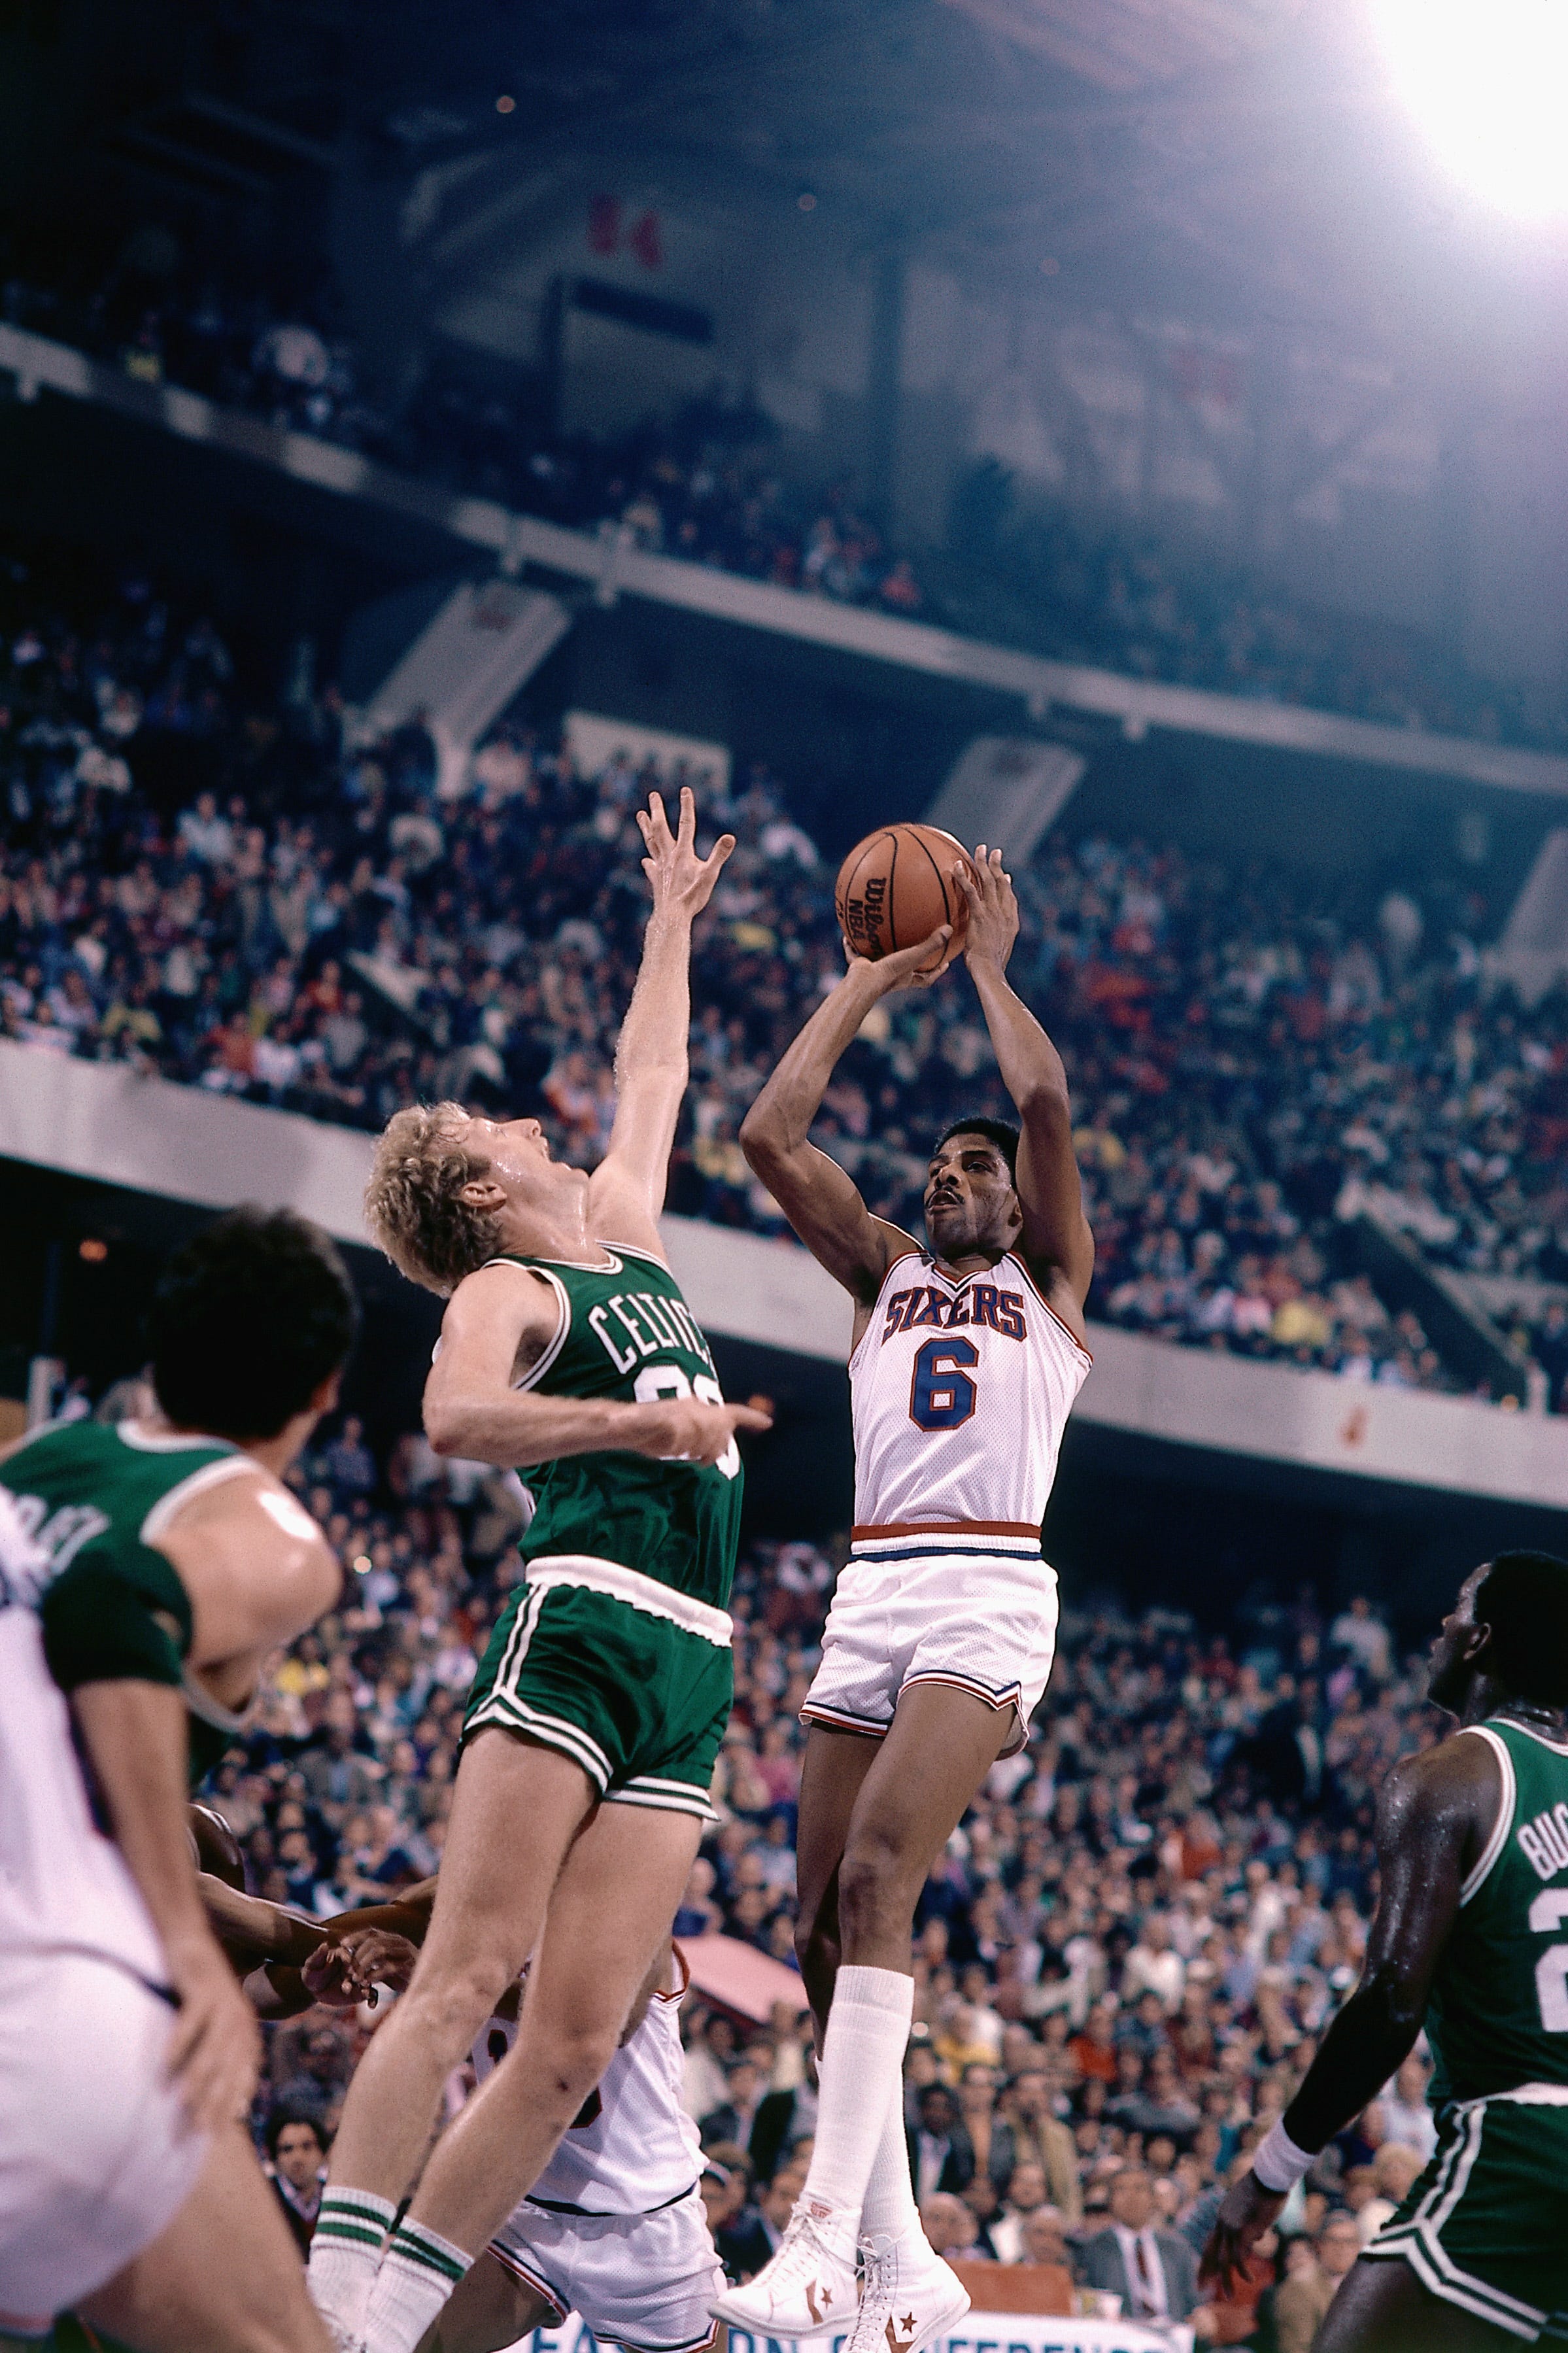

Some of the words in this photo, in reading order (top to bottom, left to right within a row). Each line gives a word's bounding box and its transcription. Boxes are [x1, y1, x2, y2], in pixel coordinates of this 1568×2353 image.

[849, 899, 866, 939] NBA
[588, 1292, 718, 1374] CELTIC
[881, 1283, 1028, 1346] SIXERS
[909, 1336, 980, 1432] 6
